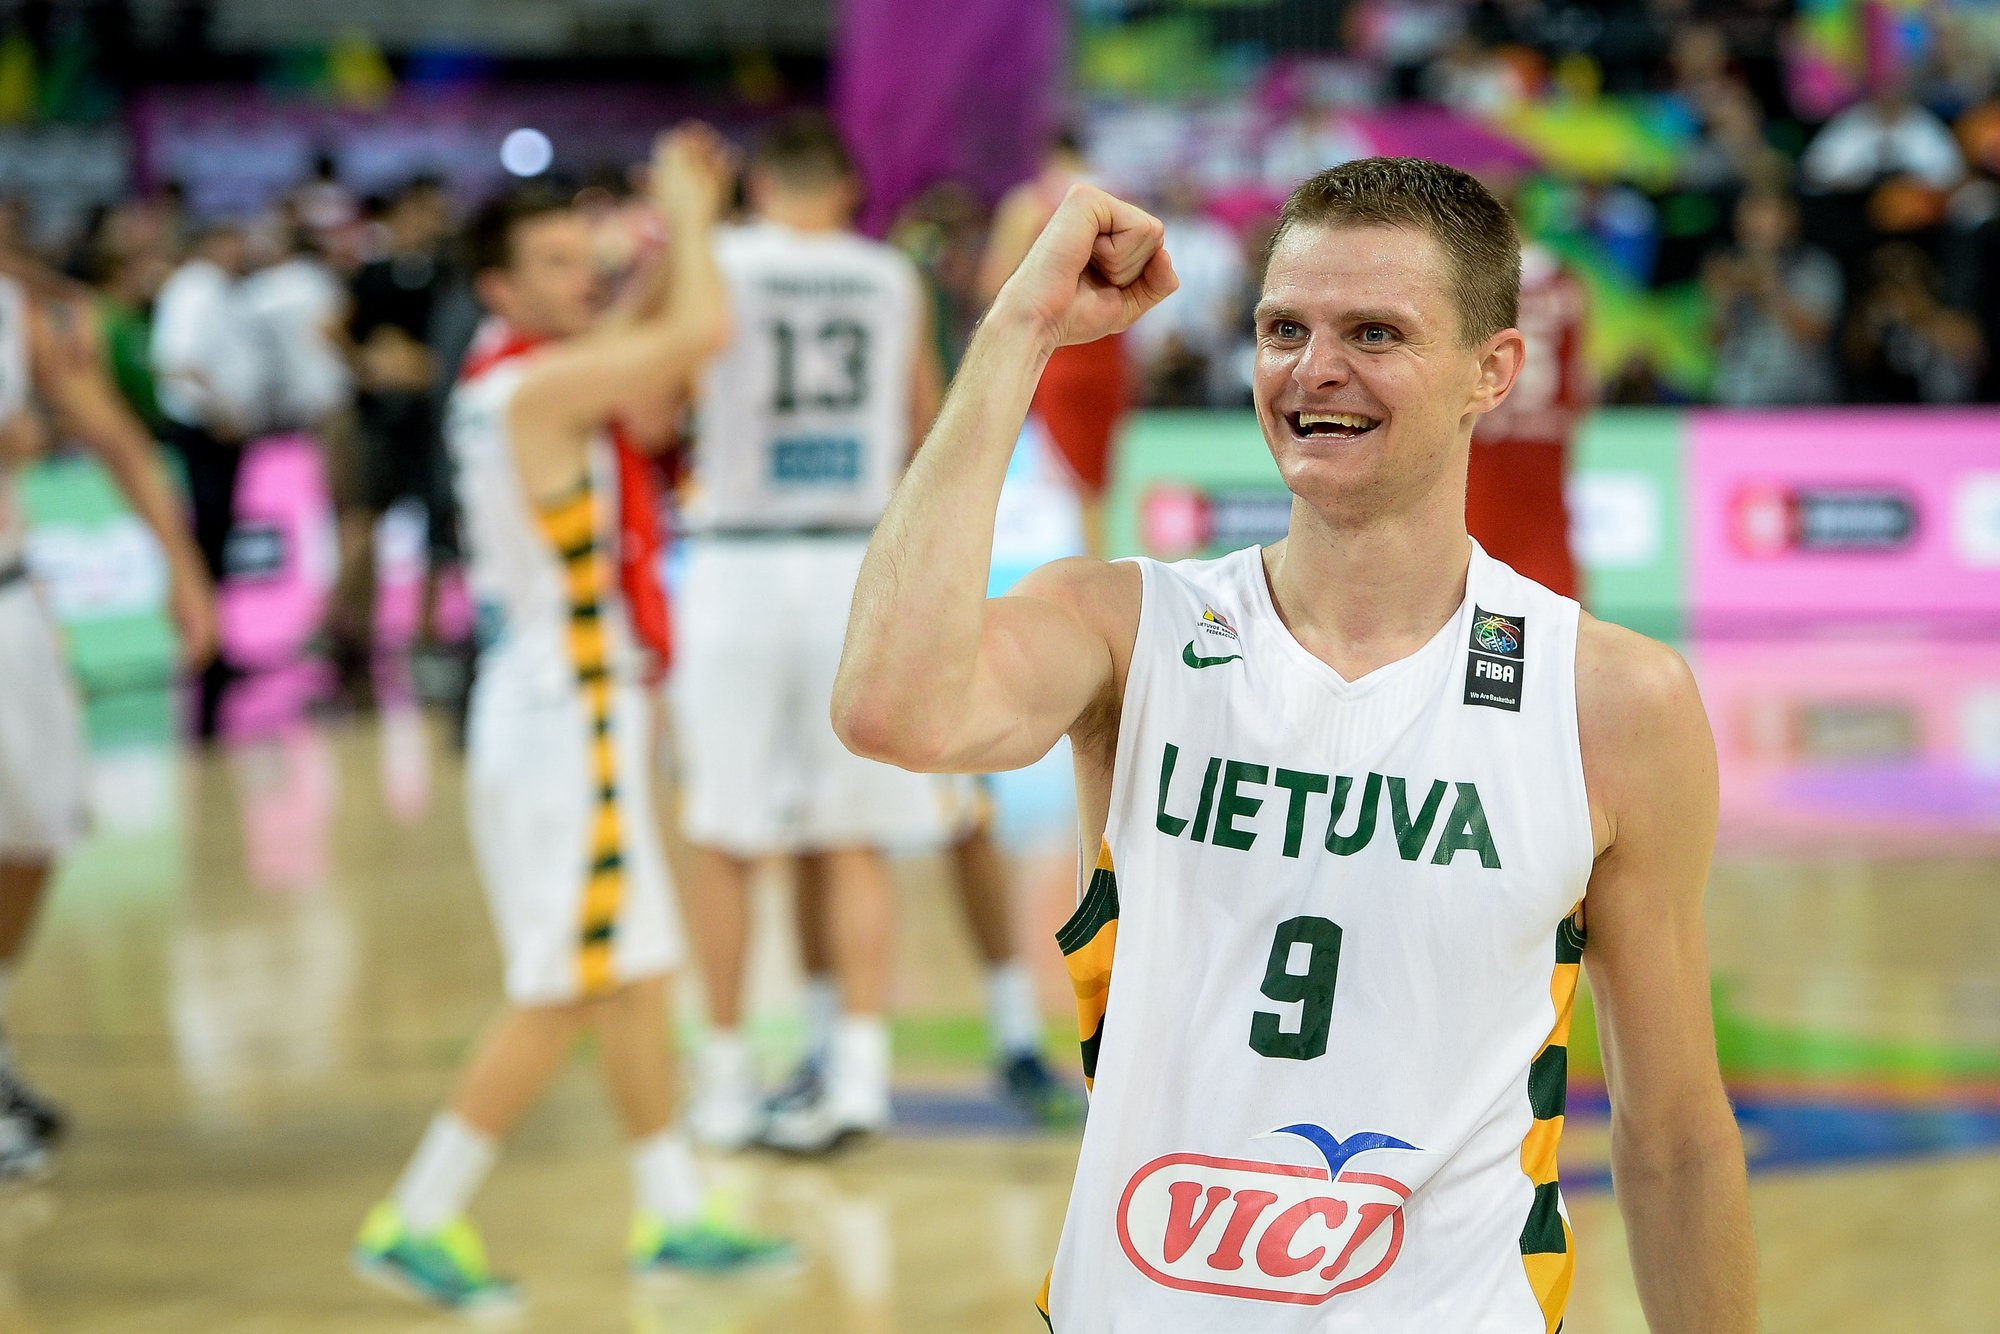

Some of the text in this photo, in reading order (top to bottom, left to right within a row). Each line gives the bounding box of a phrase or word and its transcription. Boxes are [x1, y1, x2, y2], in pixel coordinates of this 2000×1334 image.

[769, 317, 868, 413] 13
[1475, 659, 1515, 683] FIBA
[1480, 692, 1489, 700] Are
[1490, 694, 1515, 704] Basketball
[1156, 742, 1502, 869] LIETUVA
[1248, 915, 1343, 1061] 9
